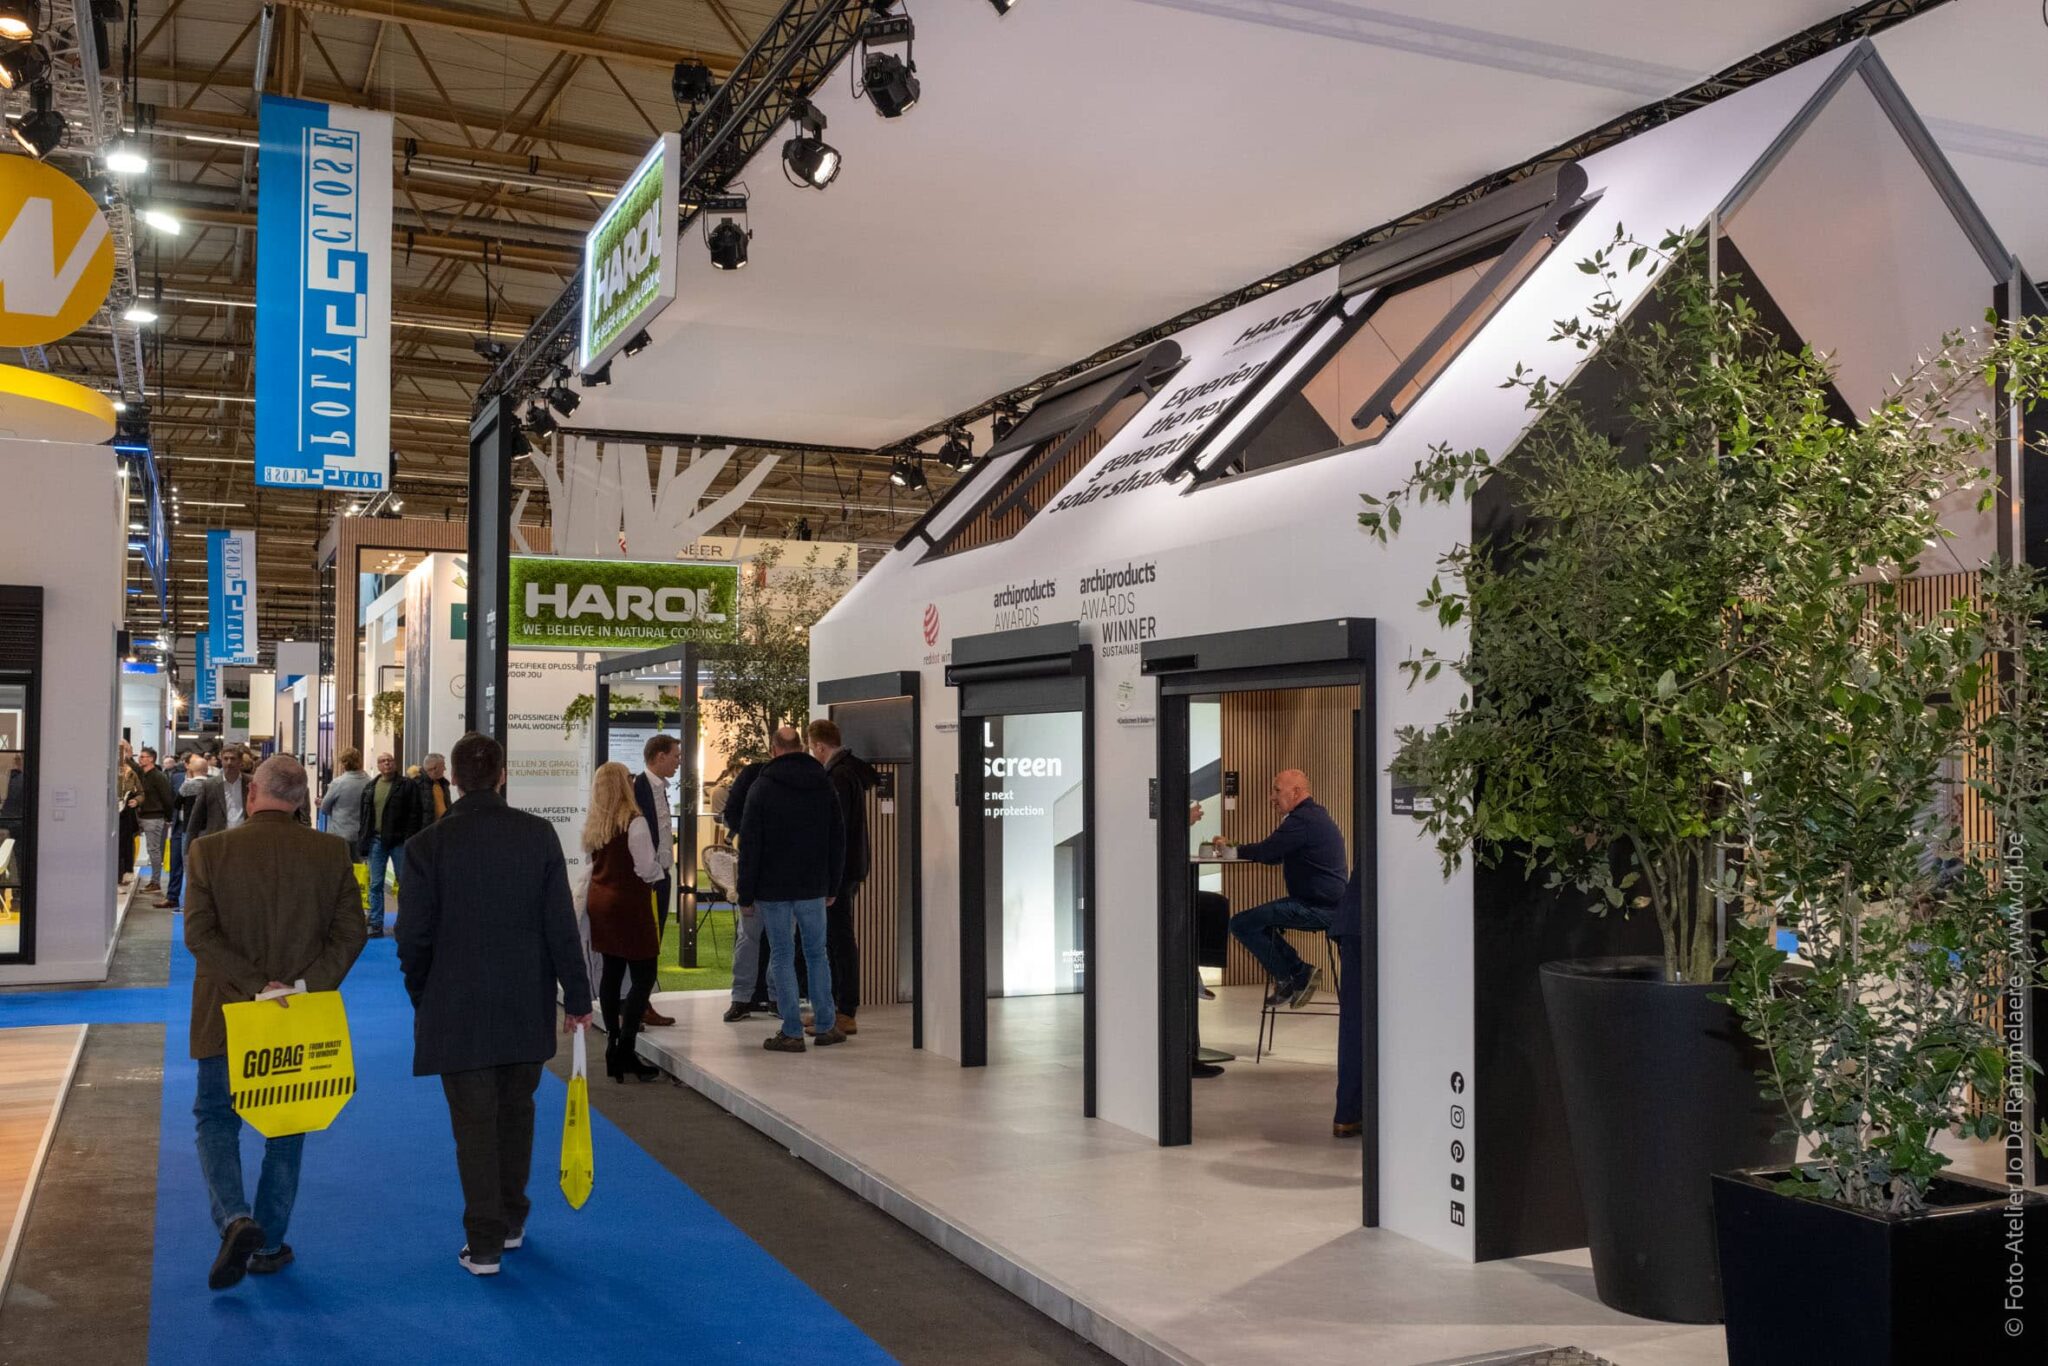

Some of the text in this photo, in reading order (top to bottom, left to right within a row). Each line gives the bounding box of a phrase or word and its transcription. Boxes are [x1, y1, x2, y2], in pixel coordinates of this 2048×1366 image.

[1142, 411, 1187, 439] the
[1049, 483, 1113, 514] solar
[1080, 562, 1156, 597] archiproducts
[525, 582, 727, 624] HAROL
[993, 579, 1056, 609] archiproducts
[1080, 592, 1136, 621] AWARDS
[523, 623, 722, 640] WE BELIEVE IN NATURAL COOING
[994, 606, 1040, 632] AWARDS
[1102, 616, 1157, 644] WINNER
[991, 789, 1014, 800] next
[993, 804, 1045, 819] protection
